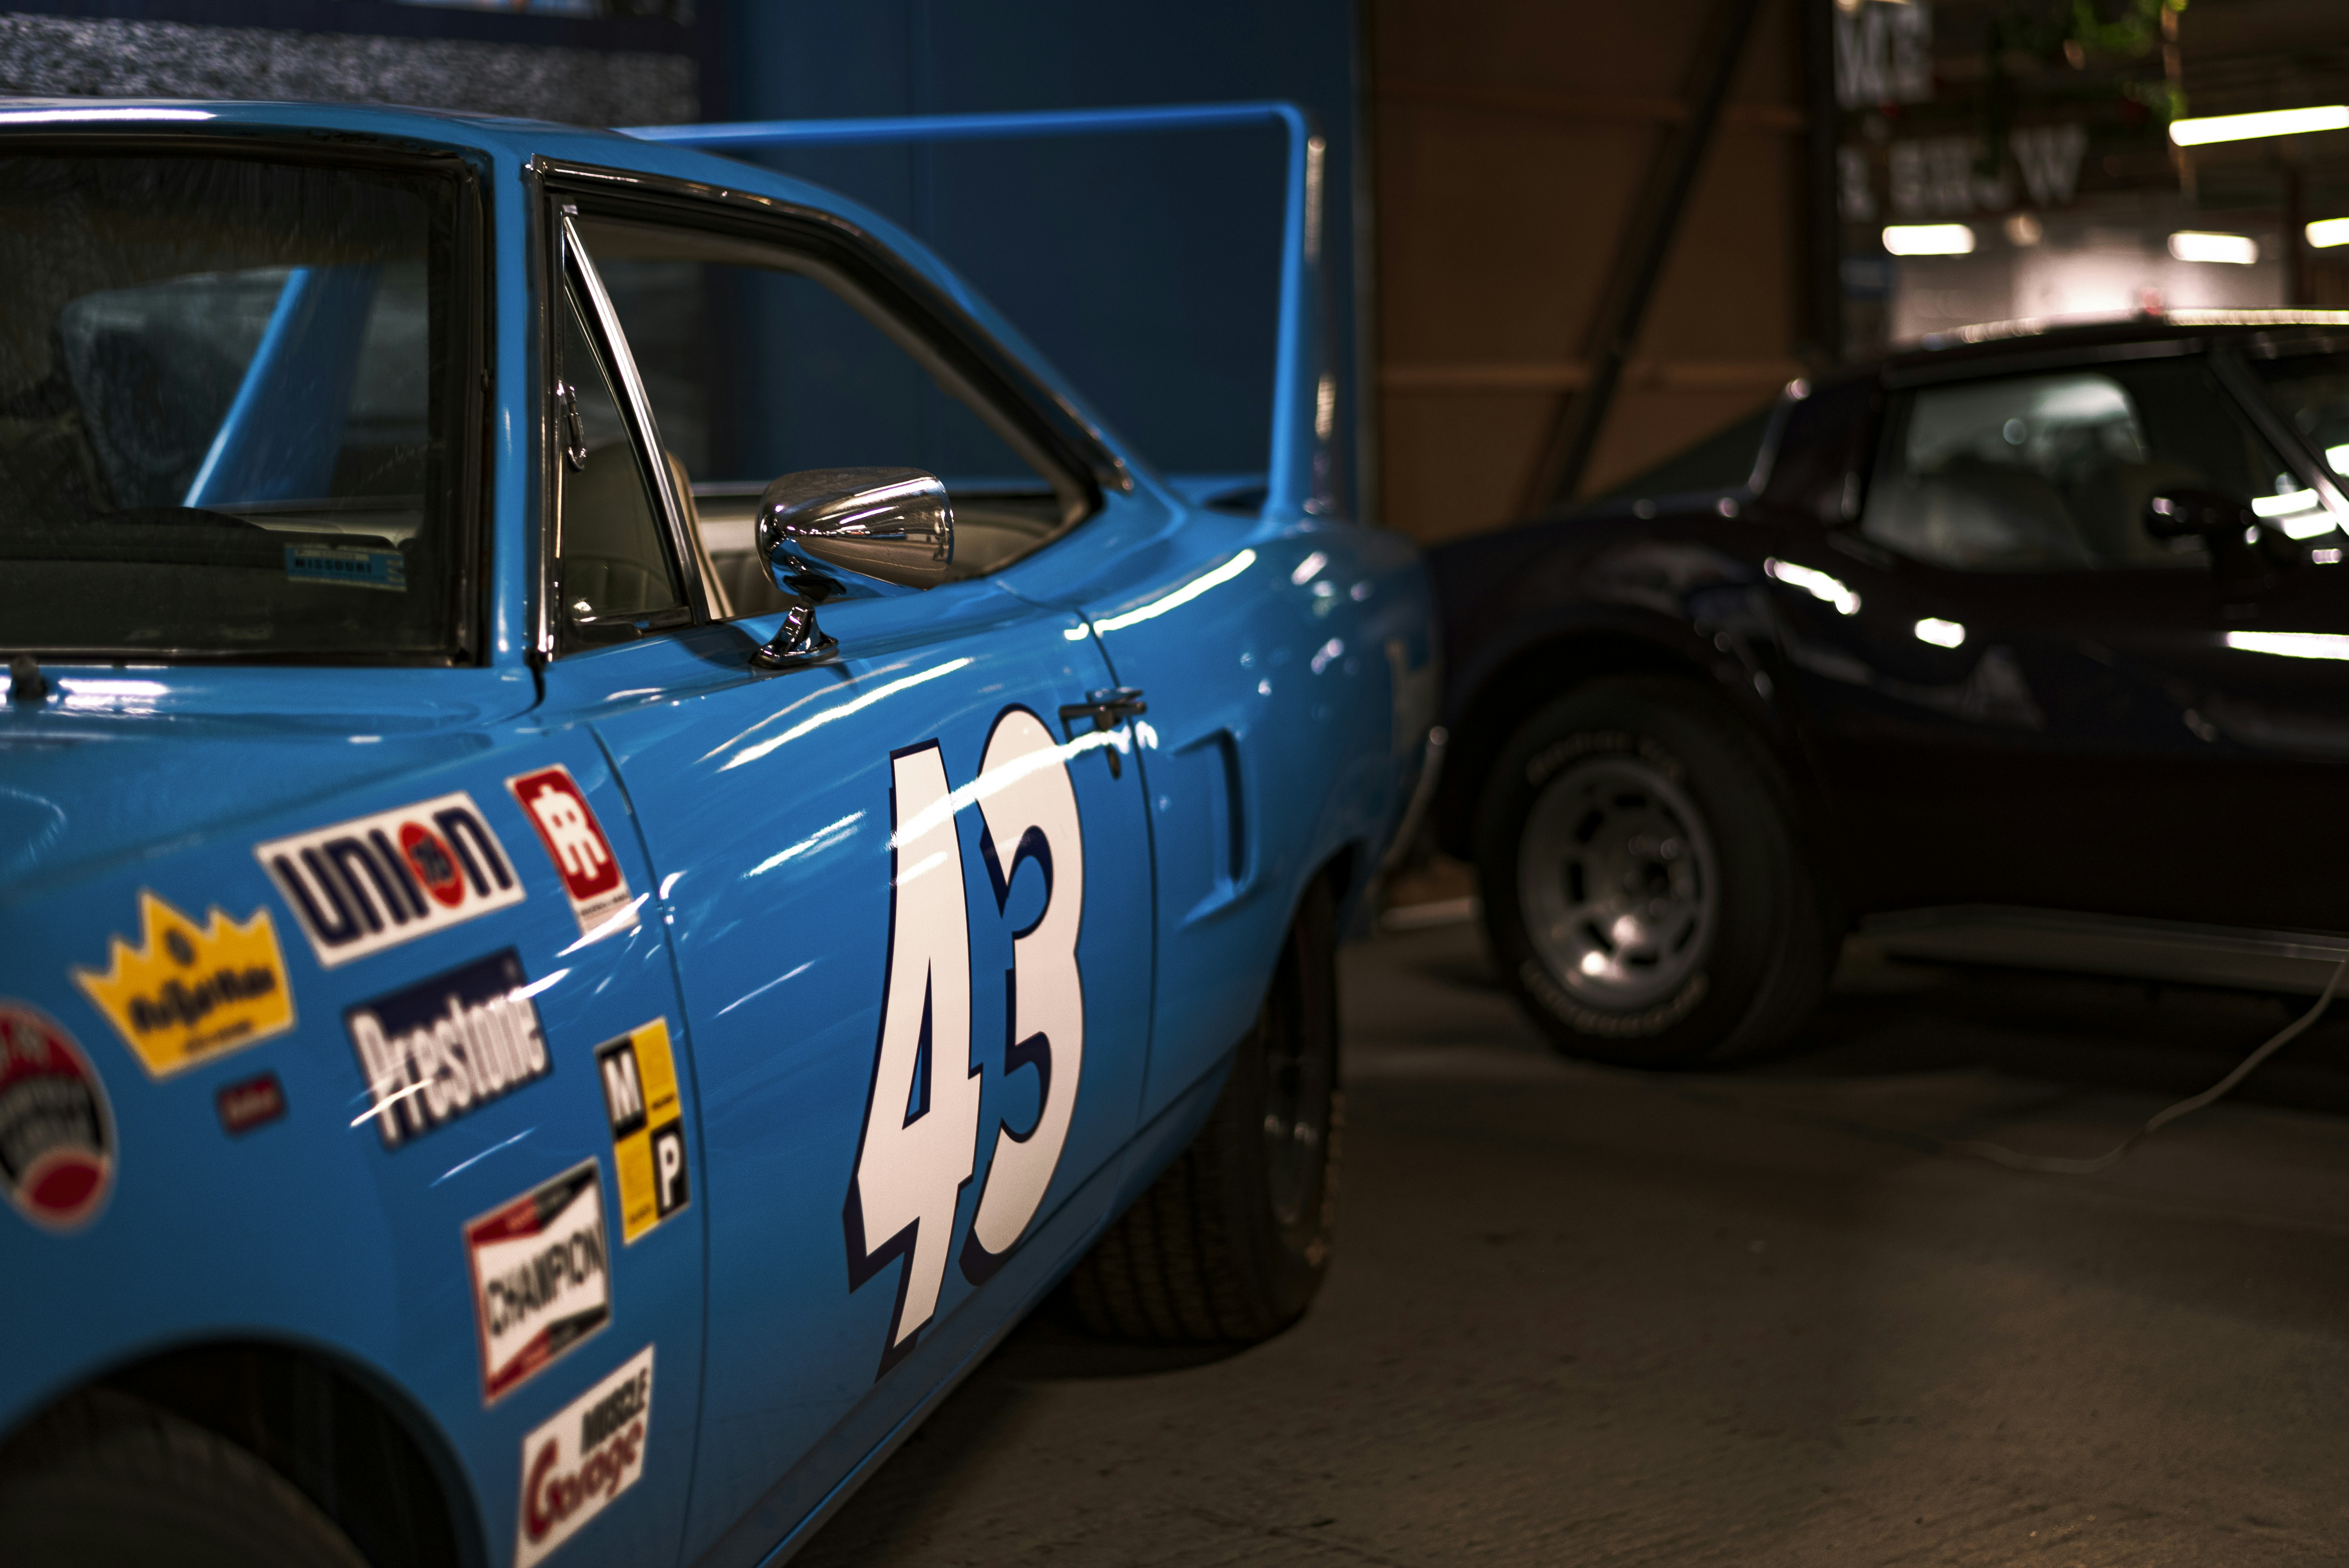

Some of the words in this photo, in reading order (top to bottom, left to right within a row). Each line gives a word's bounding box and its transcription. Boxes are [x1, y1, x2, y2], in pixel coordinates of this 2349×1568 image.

[294, 558, 372, 574] MISSOURI
[349, 985, 547, 1145] Prestone
[602, 1048, 642, 1127] M
[843, 703, 1084, 1383] 43
[656, 1130, 681, 1209] P
[485, 1222, 606, 1337] CHAMPION
[581, 1366, 649, 1457] MUSCLE
[524, 1421, 644, 1547] Garage
